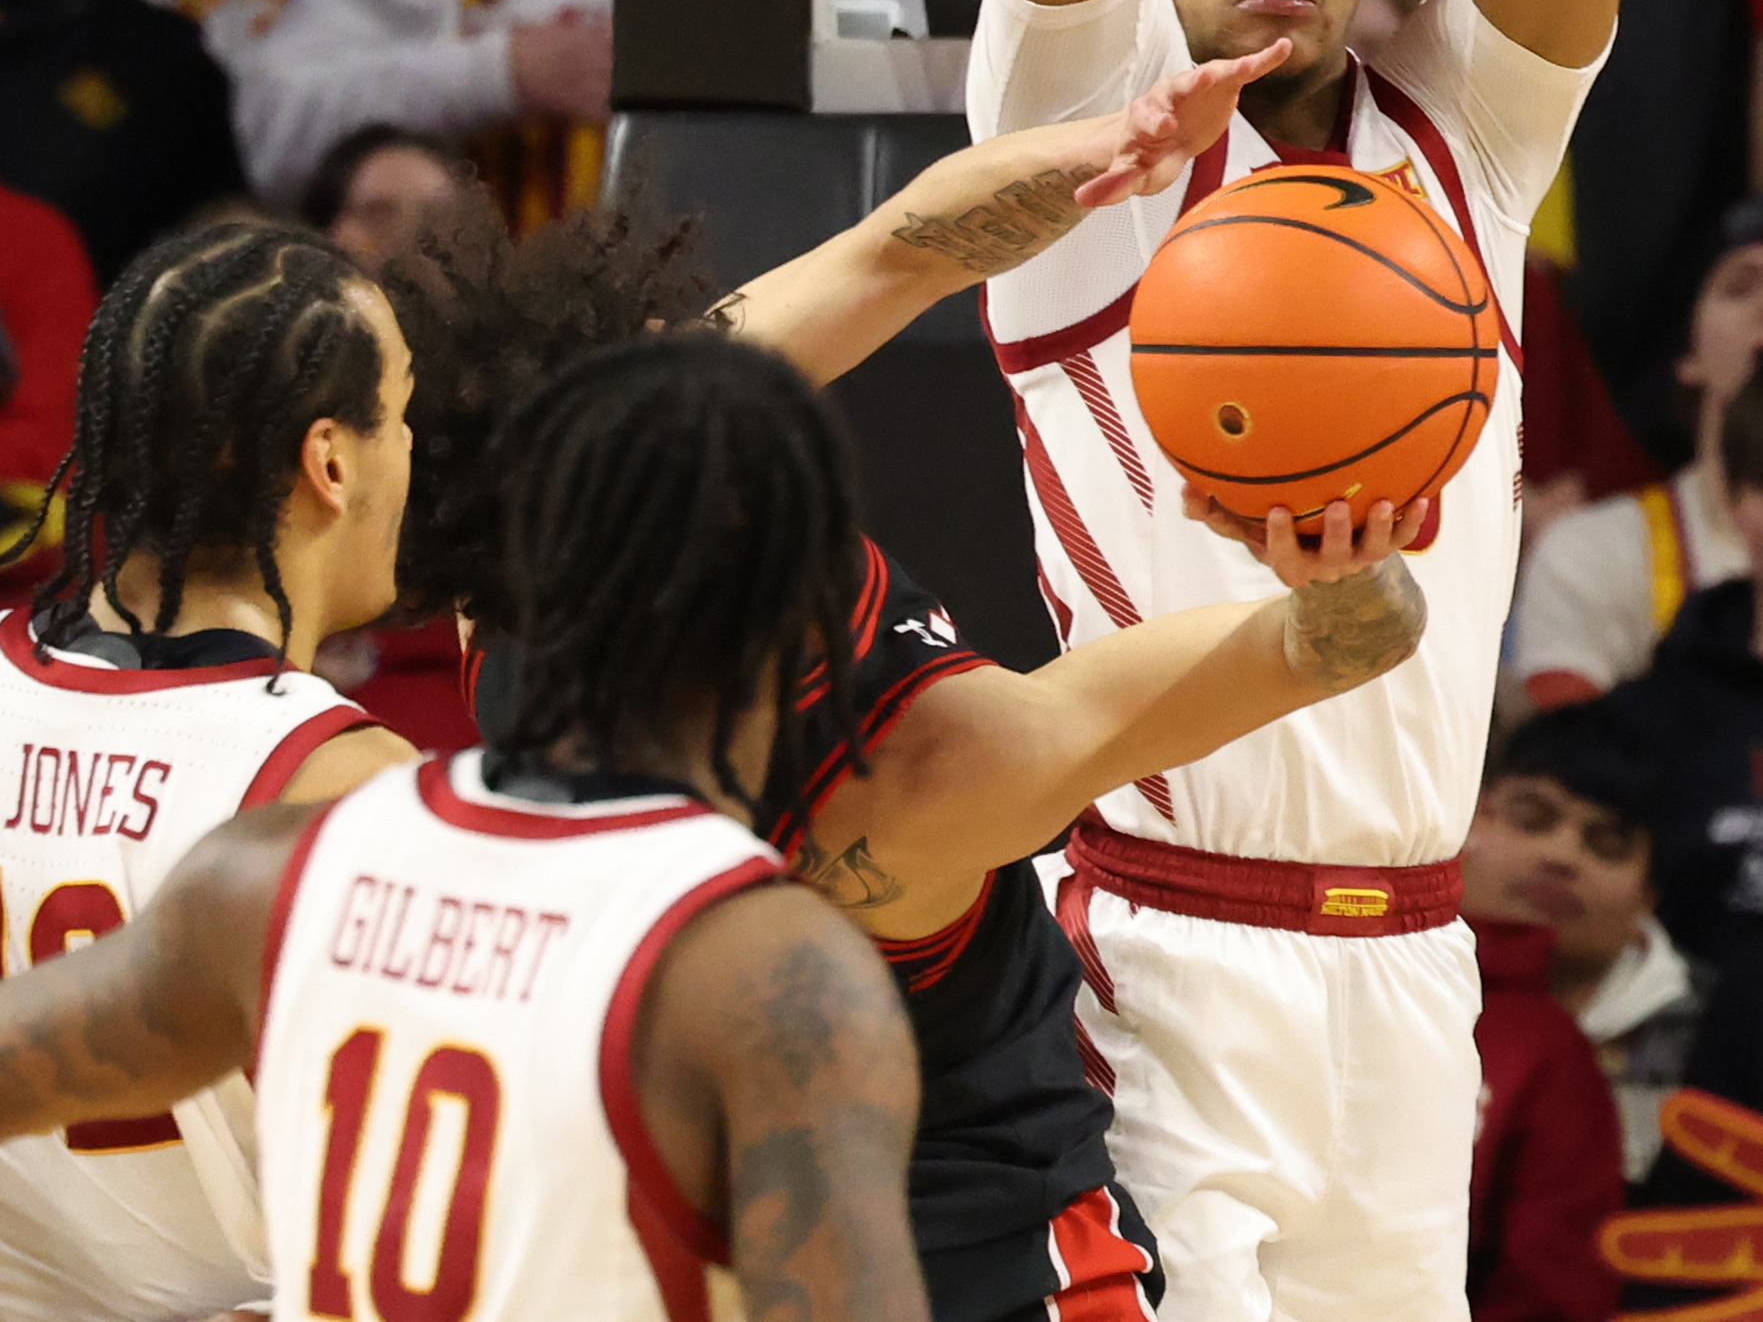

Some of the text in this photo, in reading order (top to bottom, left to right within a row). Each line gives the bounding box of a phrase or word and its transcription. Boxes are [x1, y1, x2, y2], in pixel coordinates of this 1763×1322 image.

[4, 743, 172, 842] JONES
[330, 874, 570, 1002] GILBERT
[306, 1021, 505, 1322] 10
